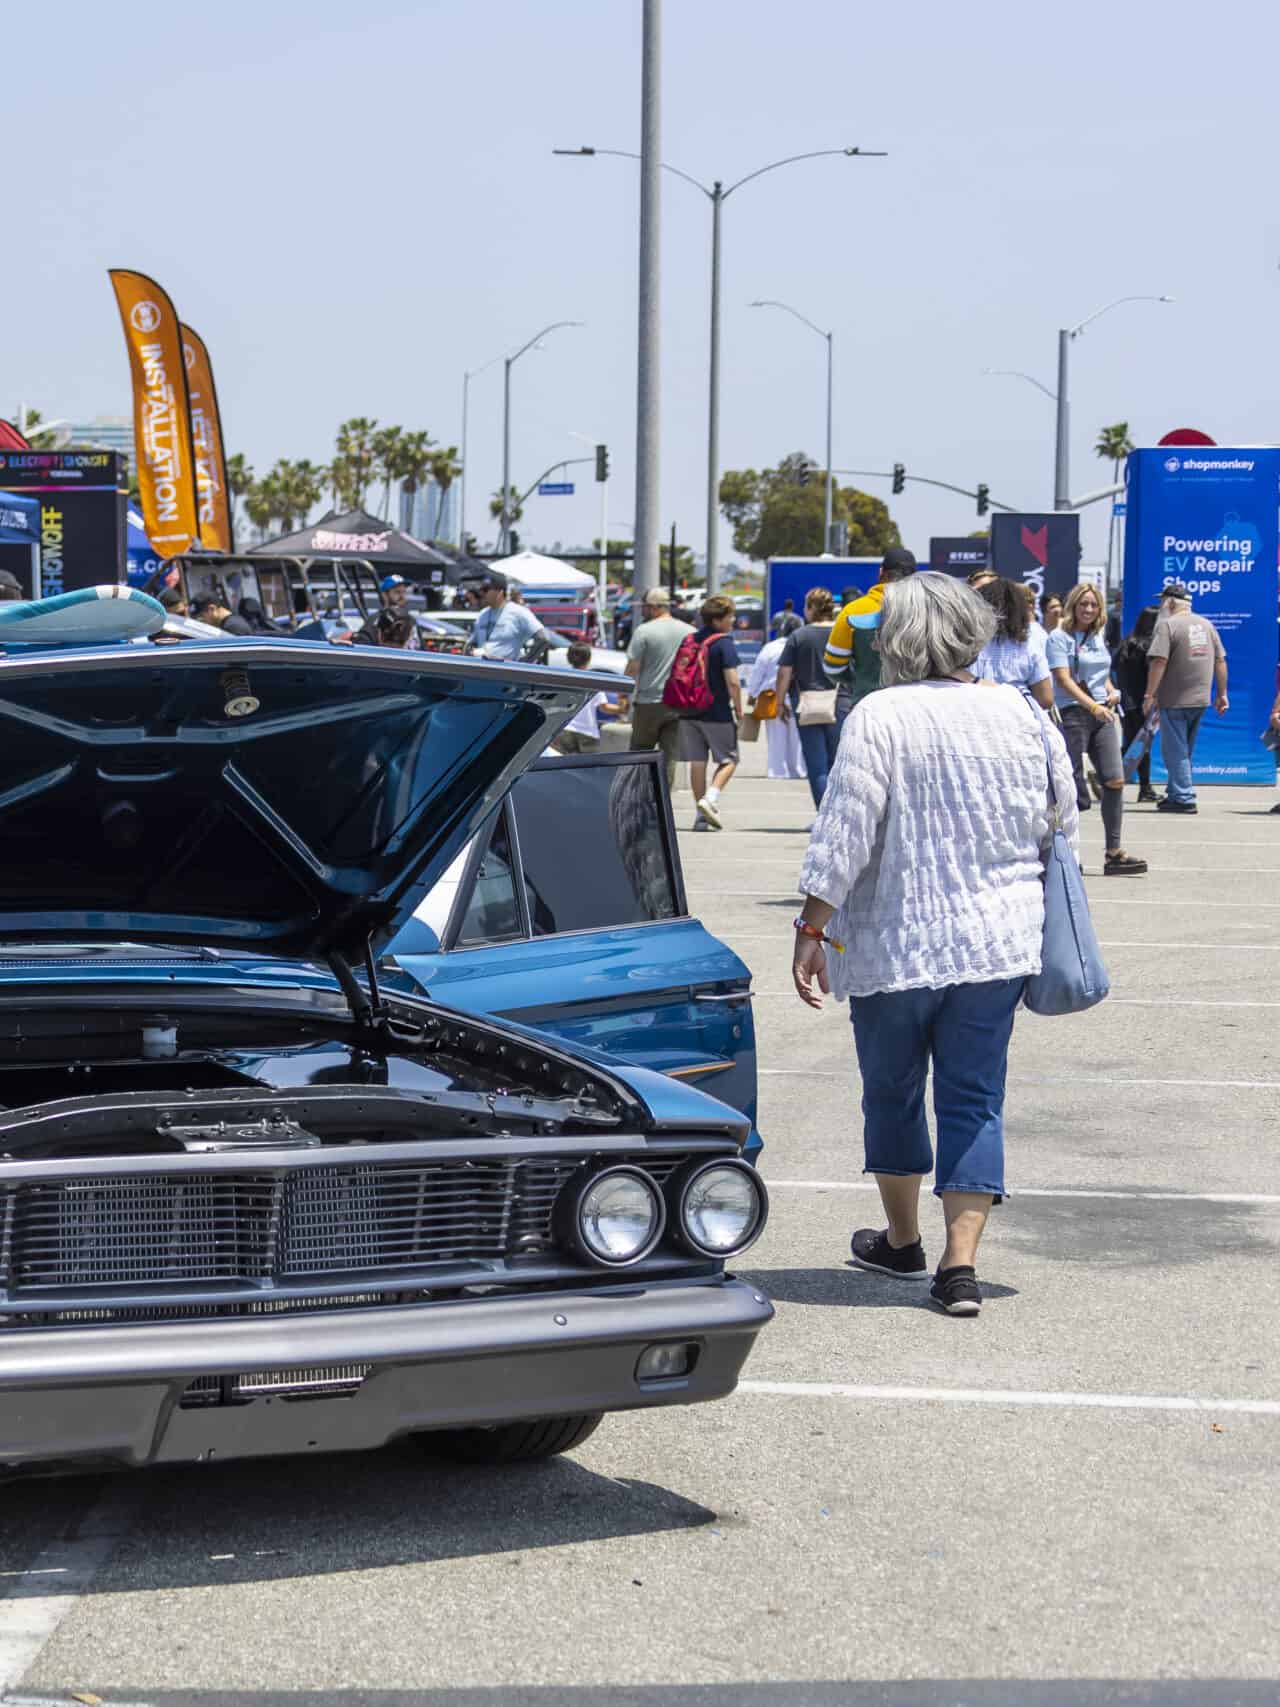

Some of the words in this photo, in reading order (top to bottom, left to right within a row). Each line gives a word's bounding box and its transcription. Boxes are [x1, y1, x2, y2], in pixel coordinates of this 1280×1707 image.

[140, 343, 180, 522] INSTALLATION
[1183, 459, 1255, 473] shopmonkey
[41, 505, 64, 597] SHOWOFF
[1163, 535, 1252, 555] Powering
[1164, 556, 1189, 572] EV
[1194, 556, 1255, 575] Repair
